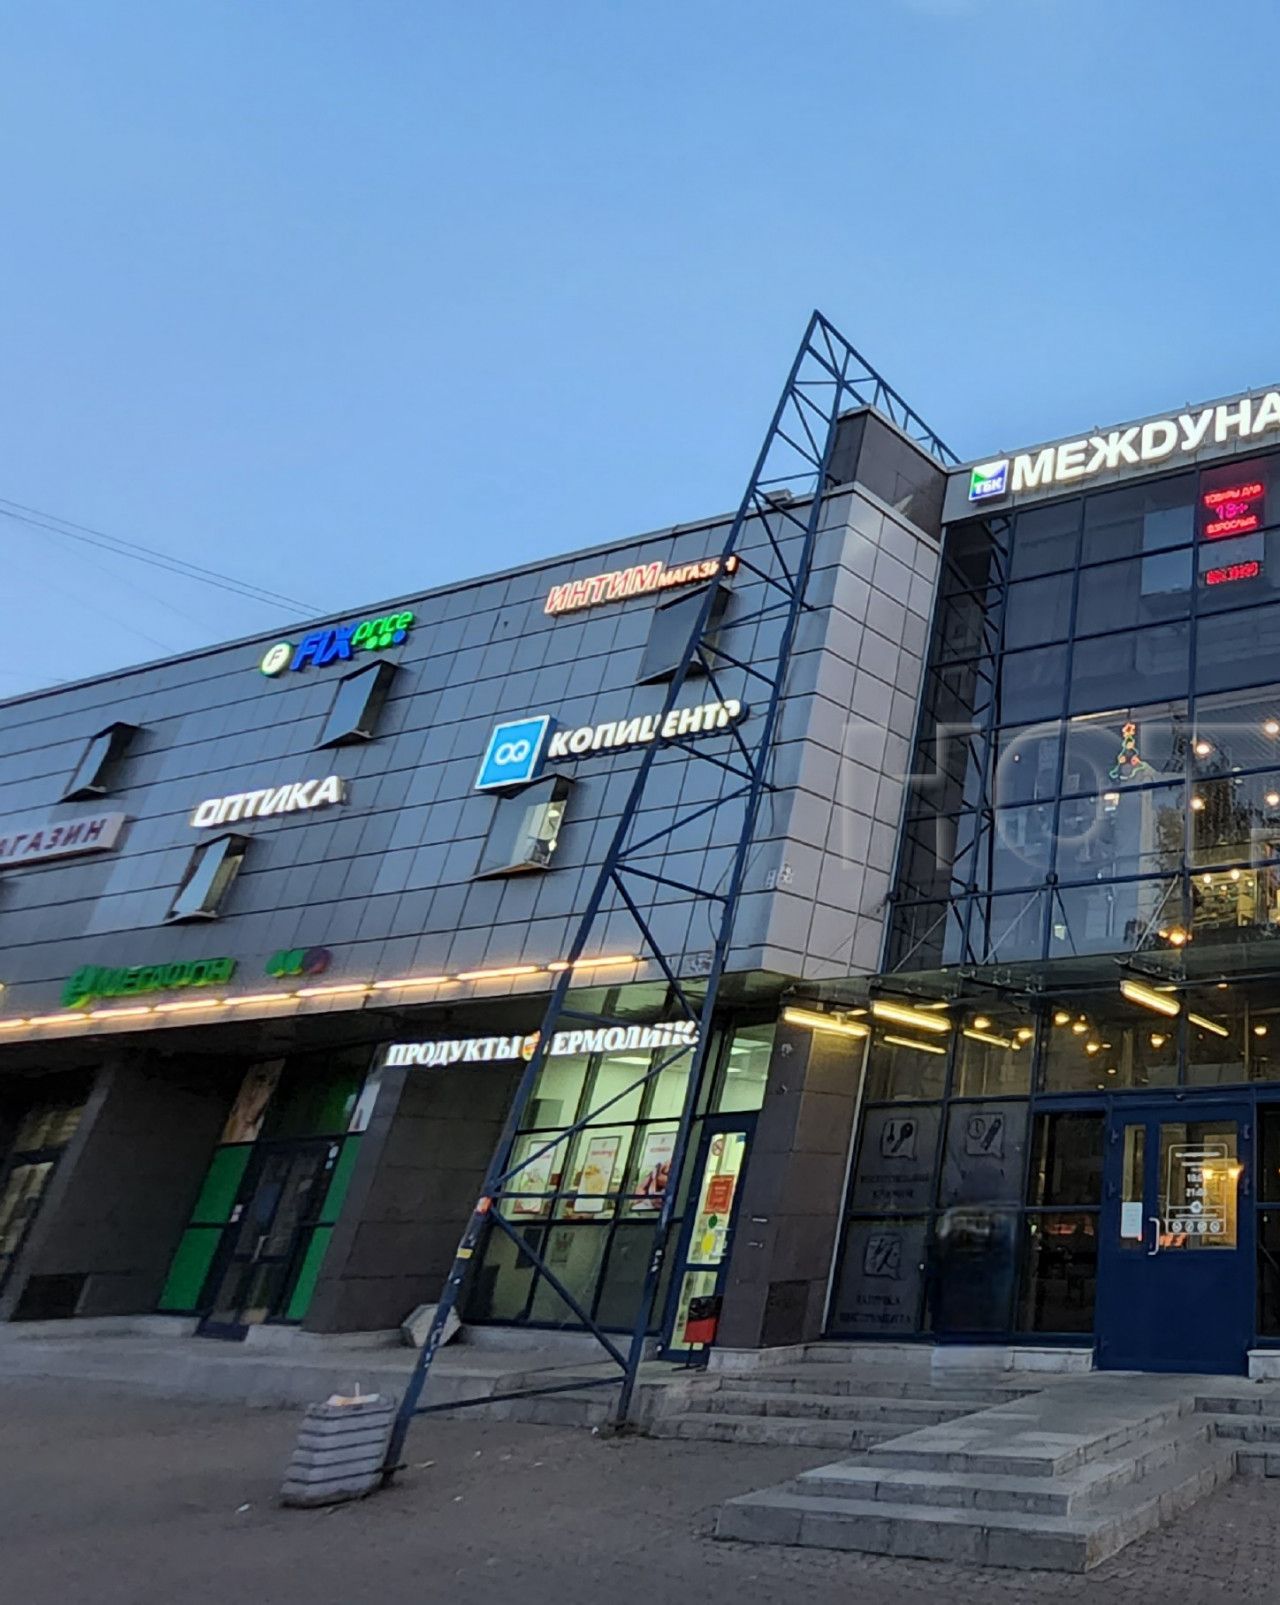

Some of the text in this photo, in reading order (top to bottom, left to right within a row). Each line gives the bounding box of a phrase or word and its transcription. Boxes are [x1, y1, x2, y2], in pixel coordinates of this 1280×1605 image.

[1216, 503, 1249, 520] 18+
[544, 560, 664, 614] ИНТИМ
[290, 611, 414, 672] FIX price
[547, 699, 742, 758] КОПИЦЕНТР
[191, 775, 344, 828] ОПТИКА
[385, 1035, 524, 1067] ПРОДУКТЫ
